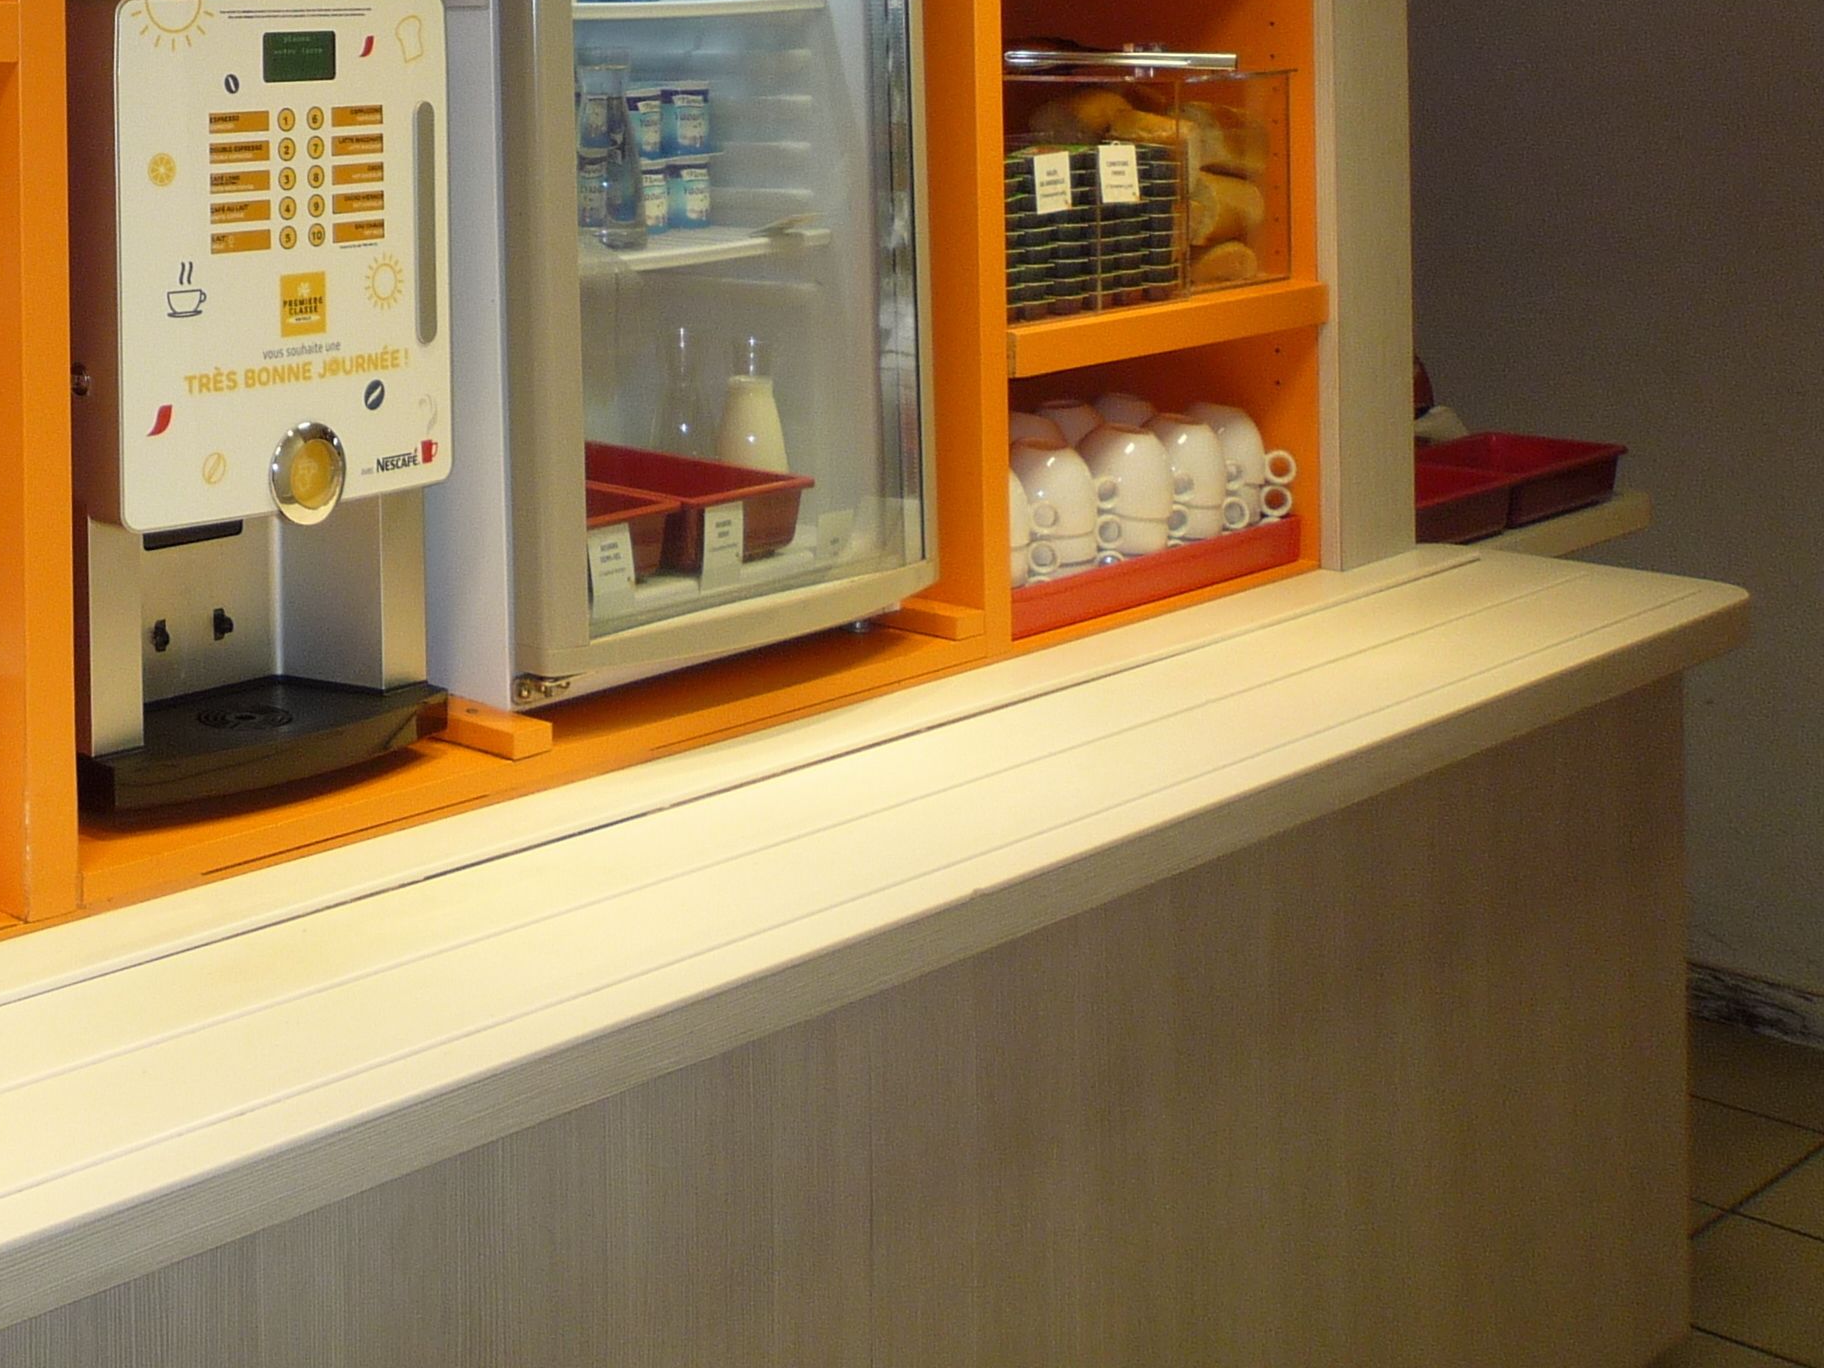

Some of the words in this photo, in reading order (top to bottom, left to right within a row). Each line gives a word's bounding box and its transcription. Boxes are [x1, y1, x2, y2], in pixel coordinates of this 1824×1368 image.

[282, 116, 288, 126] 1
[311, 114, 318, 124] 6
[283, 145, 290, 155] 2
[312, 143, 319, 153] 7
[283, 175, 290, 184] 3
[312, 173, 319, 183] 8
[284, 204, 290, 213] 4
[313, 201, 319, 211] 9
[284, 233, 291, 243] 5
[311, 231, 322, 240] 10
[288, 305, 318, 316] CLASSE
[262, 349, 285, 360] vous
[285, 342, 323, 358] souhaite
[325, 341, 342, 353] une
[184, 366, 238, 395] TRÈS
[243, 361, 313, 389] BONNE
[318, 345, 401, 379] JOURNÉE
[376, 447, 418, 473] NESCAFÉ
